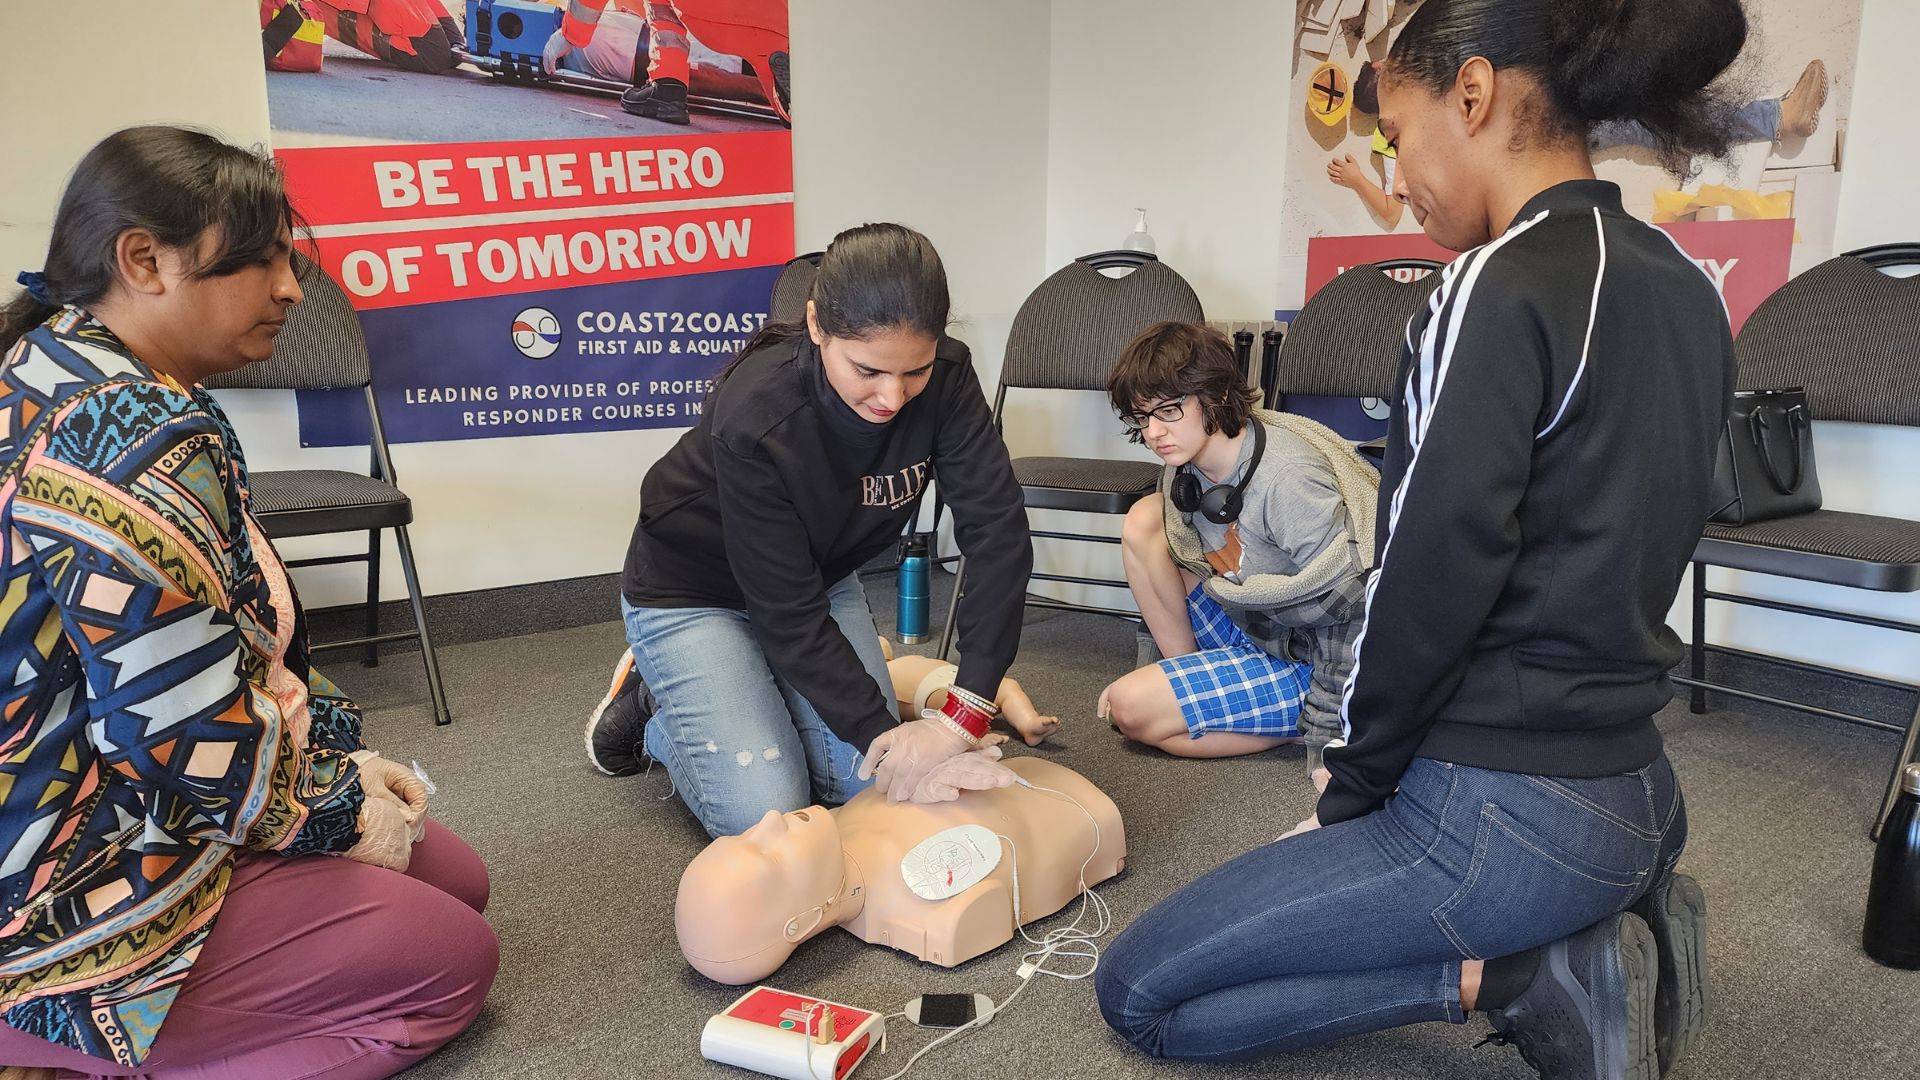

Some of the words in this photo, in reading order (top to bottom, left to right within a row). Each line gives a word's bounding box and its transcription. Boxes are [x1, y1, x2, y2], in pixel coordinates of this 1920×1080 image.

[374, 159, 459, 208] BE
[466, 154, 582, 202] THE
[589, 147, 723, 195] HERO
[341, 247, 423, 297] OF
[436, 218, 752, 287] TOMORROW
[577, 311, 768, 333] COAST2COAST
[578, 340, 627, 355] FIRST
[634, 340, 662, 354] AID
[668, 339, 682, 354] &
[405, 386, 498, 404] LEADING
[509, 382, 607, 400] PROVIDER
[616, 381, 640, 396] OF
[463, 406, 583, 426] RESPONDER
[592, 403, 676, 420] COURSES
[685, 402, 703, 416] IN
[860, 456, 931, 506] BELIE
